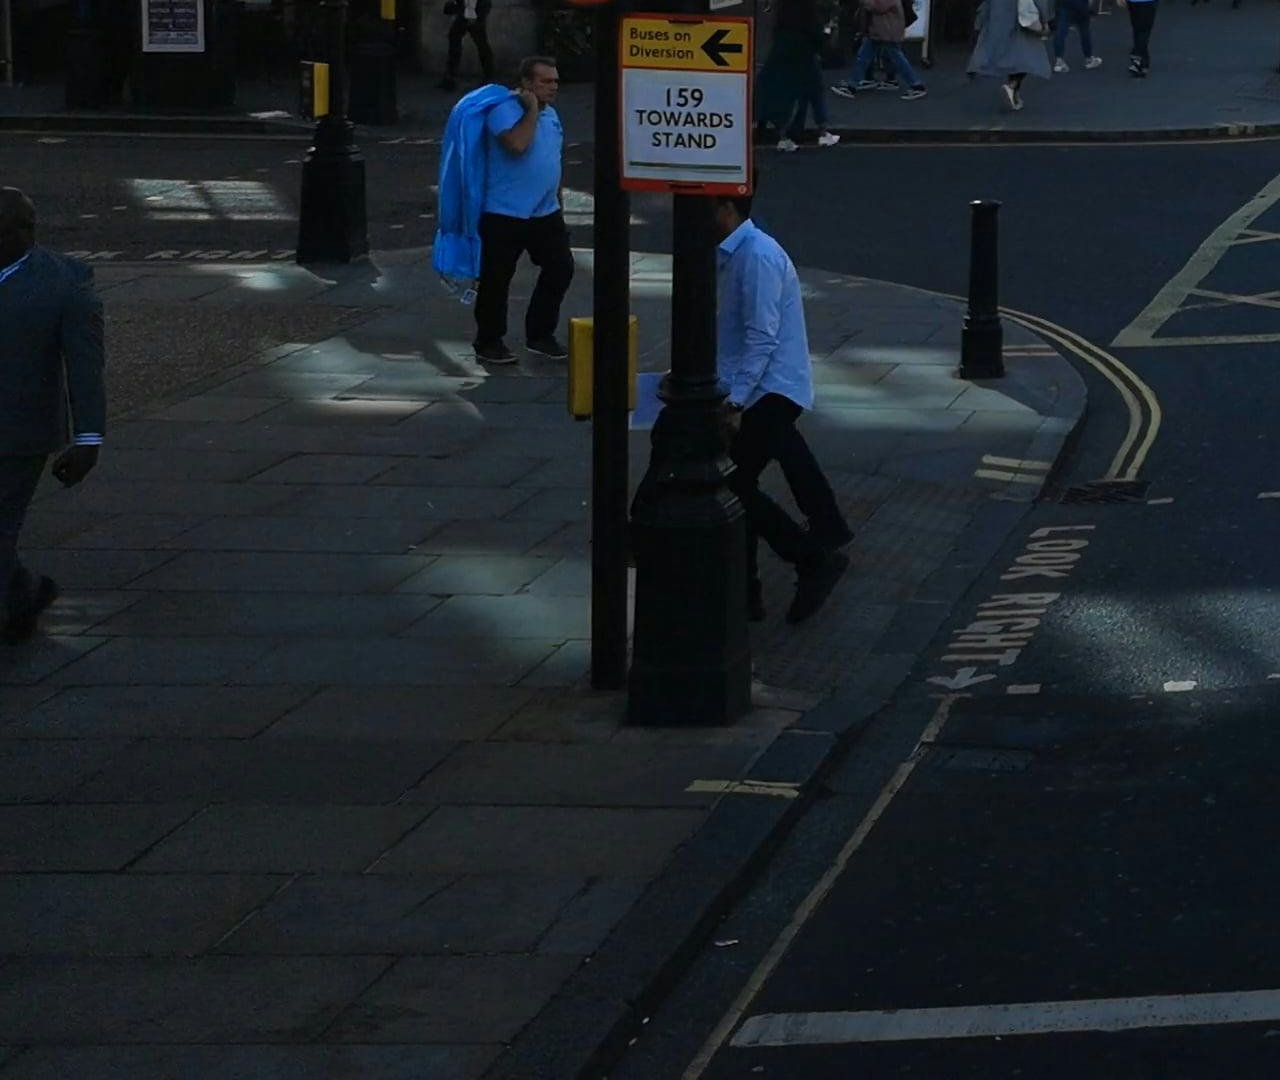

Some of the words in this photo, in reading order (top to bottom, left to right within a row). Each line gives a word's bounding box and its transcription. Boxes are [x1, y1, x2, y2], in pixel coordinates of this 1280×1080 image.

[630, 26, 670, 41] Buses
[675, 30, 692, 42] on
[629, 43, 695, 60] Diversion
[665, 87, 704, 108] 159
[635, 108, 734, 129] TOWARDS
[651, 131, 717, 150] STAND
